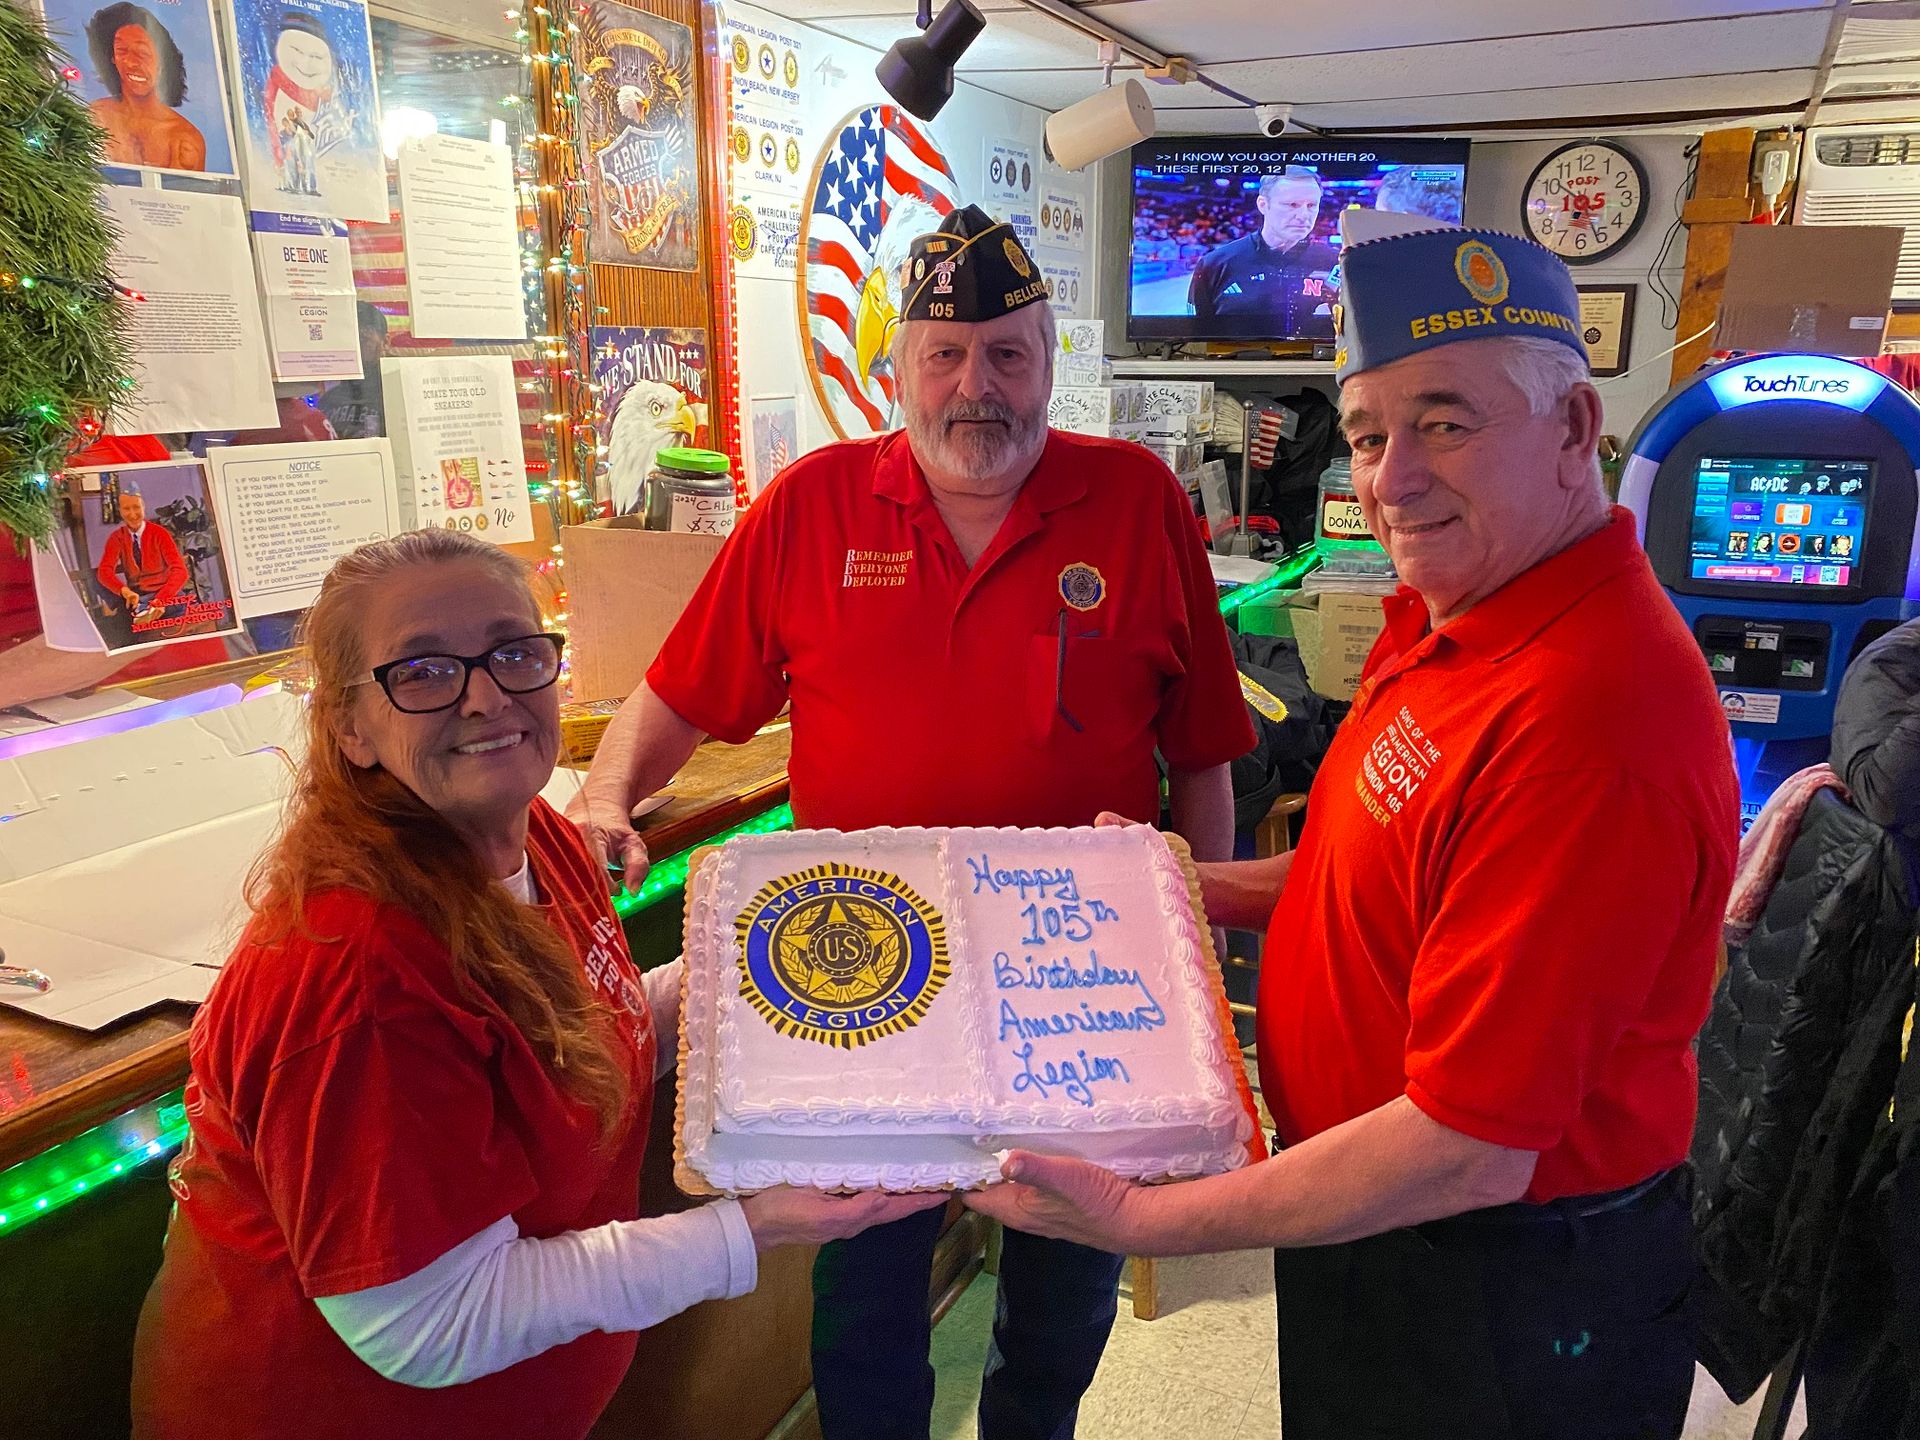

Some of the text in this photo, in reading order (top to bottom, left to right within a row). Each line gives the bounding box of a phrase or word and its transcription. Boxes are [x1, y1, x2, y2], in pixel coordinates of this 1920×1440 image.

[727, 18, 756, 34] AMERICAN
[758, 28, 778, 42] LEGION
[780, 35, 792, 46] POST
[768, 86, 780, 96] NEW
[781, 88, 800, 100] JERSEY
[735, 112, 757, 124] ERICAN
[759, 118, 778, 130] LEGION
[780, 123, 794, 134] POST
[614, 139, 658, 176] ARMED
[1182, 153, 1224, 162] KNOW
[1228, 153, 1256, 162] YOU
[1260, 153, 1288, 162] GOT
[1292, 153, 1356, 162] ANOTHER
[1359, 153, 1378, 162] 20.
[1576, 154, 1595, 171] 12
[1603, 158, 1610, 174] 1
[622, 164, 657, 186] FORCES
[1156, 164, 1198, 174] THESE
[1202, 164, 1240, 174] FIRST
[1266, 164, 1281, 174] 12
[1556, 162, 1571, 178] 11
[774, 174, 782, 184] NJ
[1542, 178, 1560, 196] 10
[1567, 176, 1600, 189] POST
[1616, 172, 1628, 189] 2
[1562, 192, 1606, 212] 105
[1620, 190, 1632, 208] 3
[758, 206, 788, 219] AMERICAN
[1611, 212, 1622, 228] 4
[1542, 219, 1552, 236] 8
[1597, 226, 1608, 243] 5
[1557, 230, 1568, 246] 7
[1576, 232, 1587, 250] 6
[283, 246, 328, 264] BE THE ONE
[760, 244, 776, 254] CAPE
[1303, 278, 1324, 296] N
[928, 302, 954, 318] 105
[1410, 307, 1497, 340] ESSEX
[600, 342, 702, 398] WE STAND FOR
[449, 388, 468, 398] YOUR
[470, 388, 486, 396] OLD
[1744, 375, 1850, 394] TouchTunes
[1064, 394, 1090, 411] CLAW
[1160, 388, 1182, 404] CLAW
[289, 461, 320, 471] NOTICE
[674, 496, 696, 506] 2024
[494, 508, 516, 528] No
[1346, 505, 1362, 516] FO
[1328, 516, 1368, 530] DONAT
[846, 549, 913, 562] REMEMBER
[844, 562, 908, 575] EVERYONE
[842, 574, 905, 588] DEPLOYED
[132, 610, 225, 632] NEIGHBORHOOD
[1400, 706, 1442, 763] SONS OF THE
[1372, 732, 1420, 800] LEGION
[1390, 736, 1429, 782] AMERICAN
[1386, 792, 1404, 814] 105
[966, 854, 1080, 900] Happy
[758, 879, 919, 933] AMERICAN
[993, 950, 1150, 995] Birthday
[782, 991, 909, 1028] LEGION
[998, 998, 1153, 1042] American
[1013, 1042, 1130, 1108] Legion
